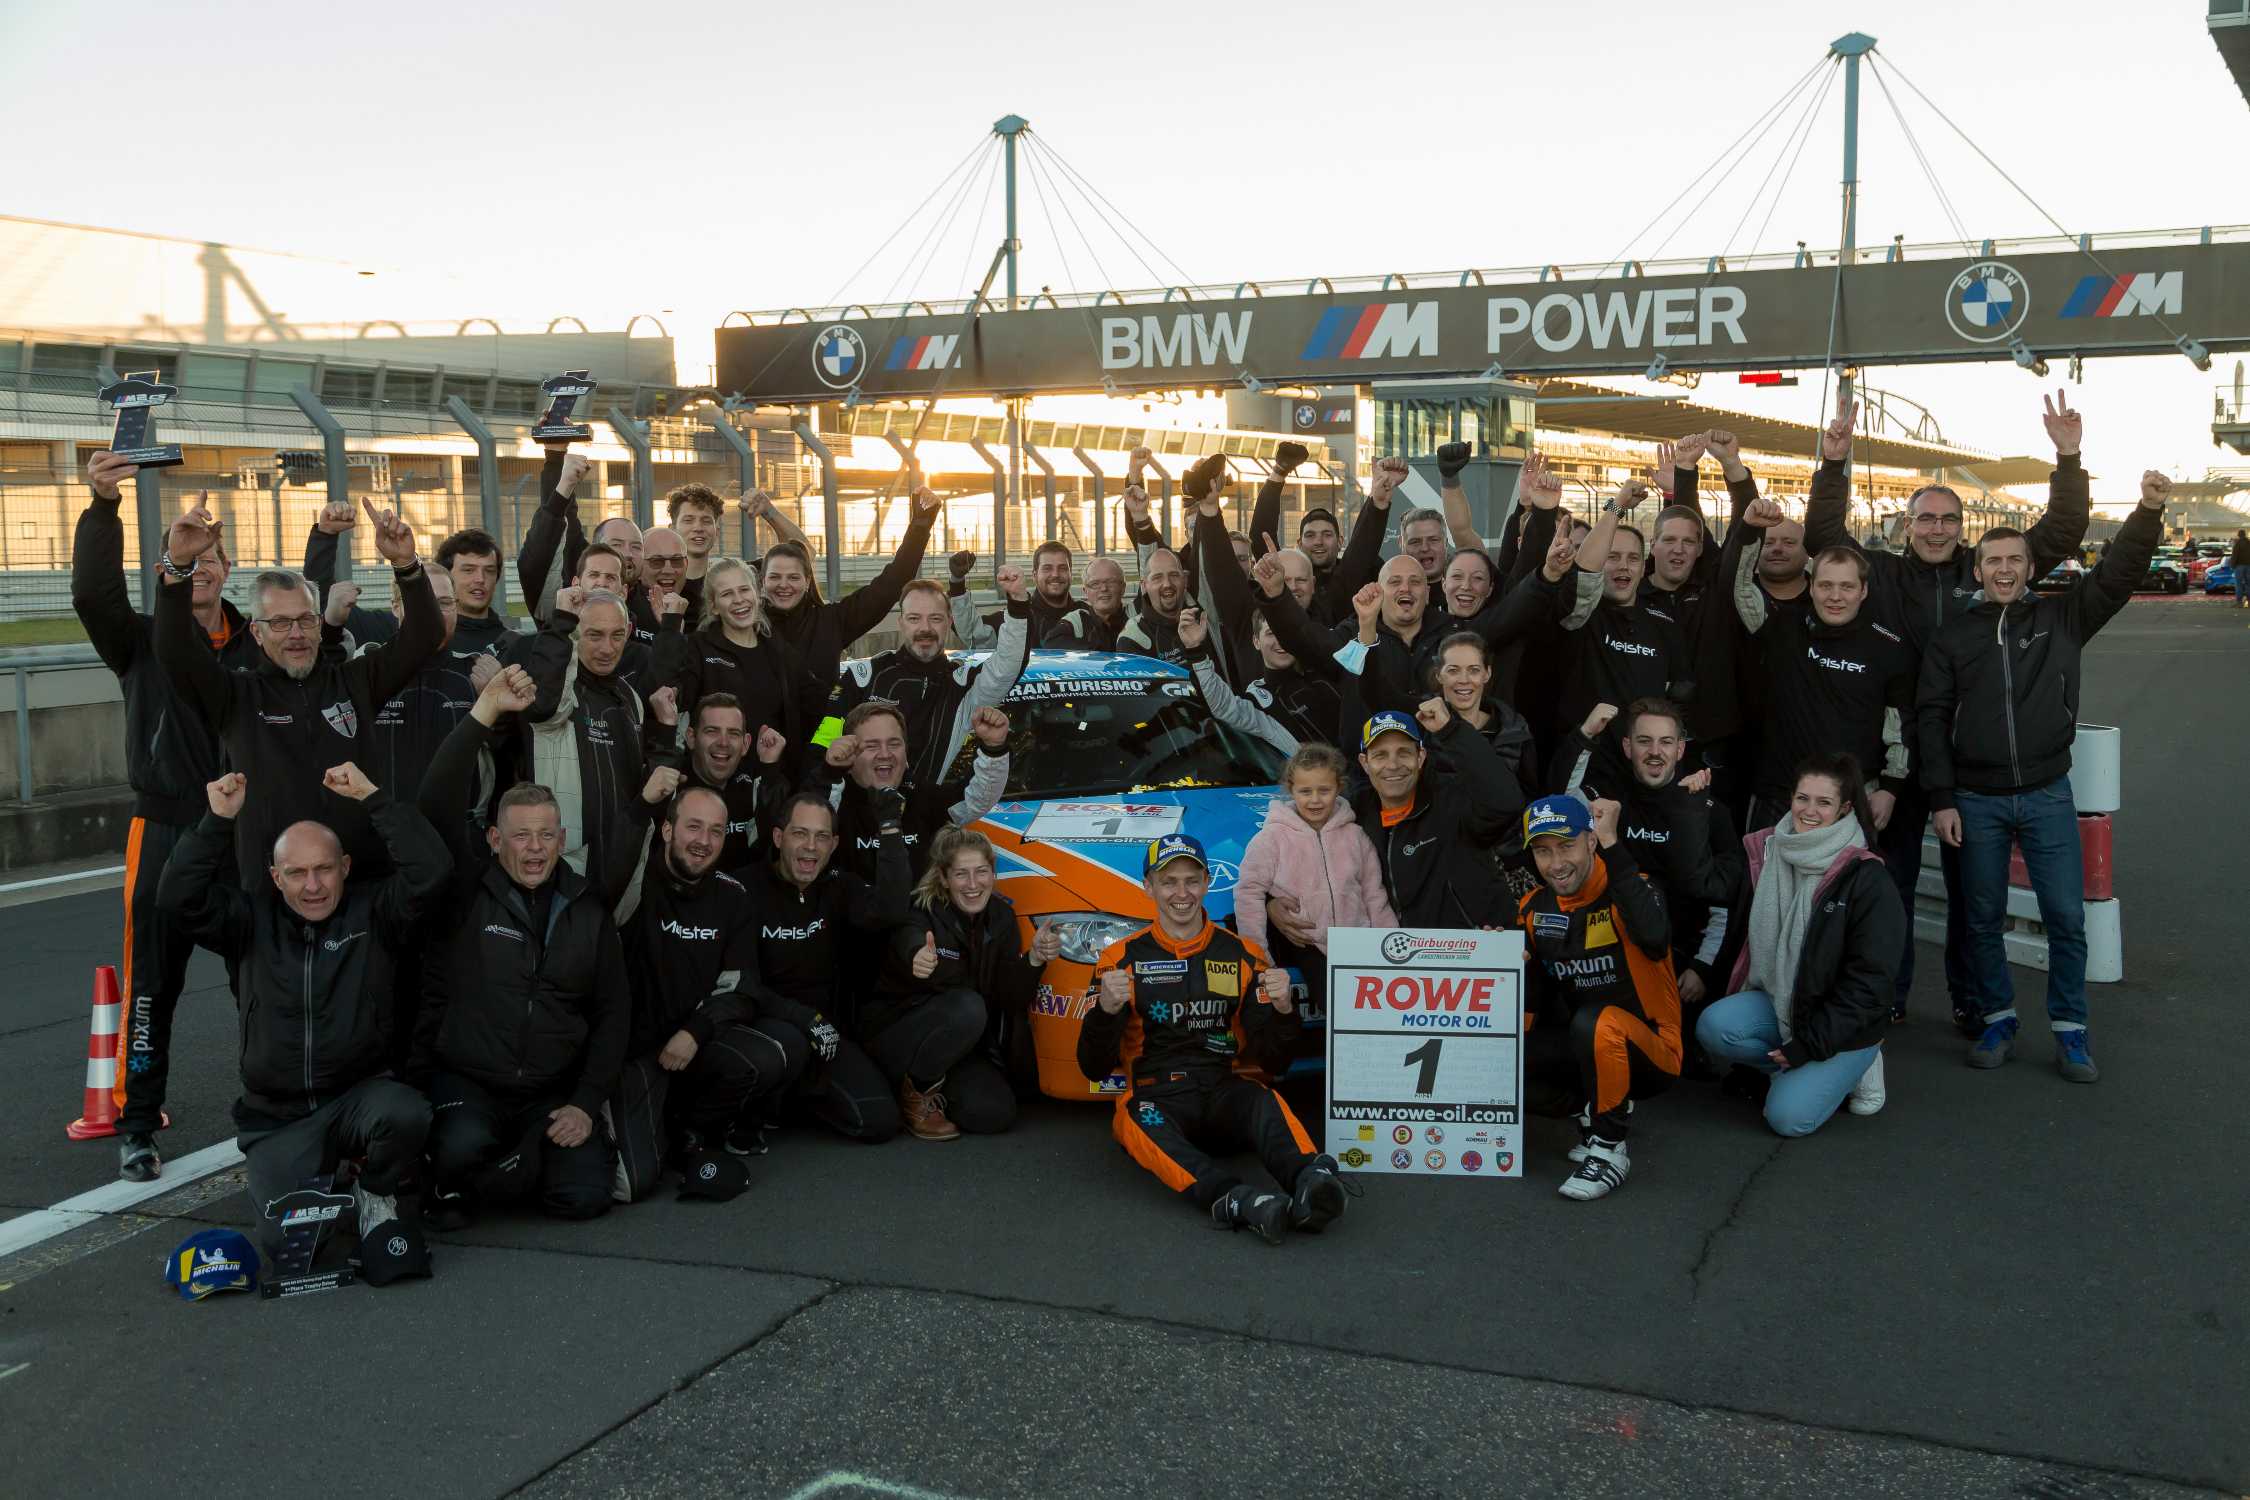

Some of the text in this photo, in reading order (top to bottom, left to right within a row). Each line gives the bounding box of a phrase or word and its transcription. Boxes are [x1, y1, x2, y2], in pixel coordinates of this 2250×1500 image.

[1958, 266, 2019, 290] BMW
[819, 327, 860, 347] BMW
[1102, 311, 1253, 370] BMW
[1487, 286, 1748, 354] POWER
[1009, 682, 1050, 698] RAN
[1055, 679, 1144, 694] TURISMO
[1091, 818, 1122, 836] 1
[1409, 936, 1477, 951] nürburgring
[1207, 962, 1237, 975] ADAC
[1554, 955, 1615, 981] pixum
[1354, 976, 1496, 1012] ROWE
[1172, 1000, 1227, 1024] pixum
[1401, 1014, 1492, 1028] MOTOR OIL
[132, 996, 154, 1052] pixum
[1403, 1038, 1443, 1097] 1
[1332, 1104, 1514, 1123] www.rowe-oil.com
[193, 1263, 241, 1279] MICHELIN
